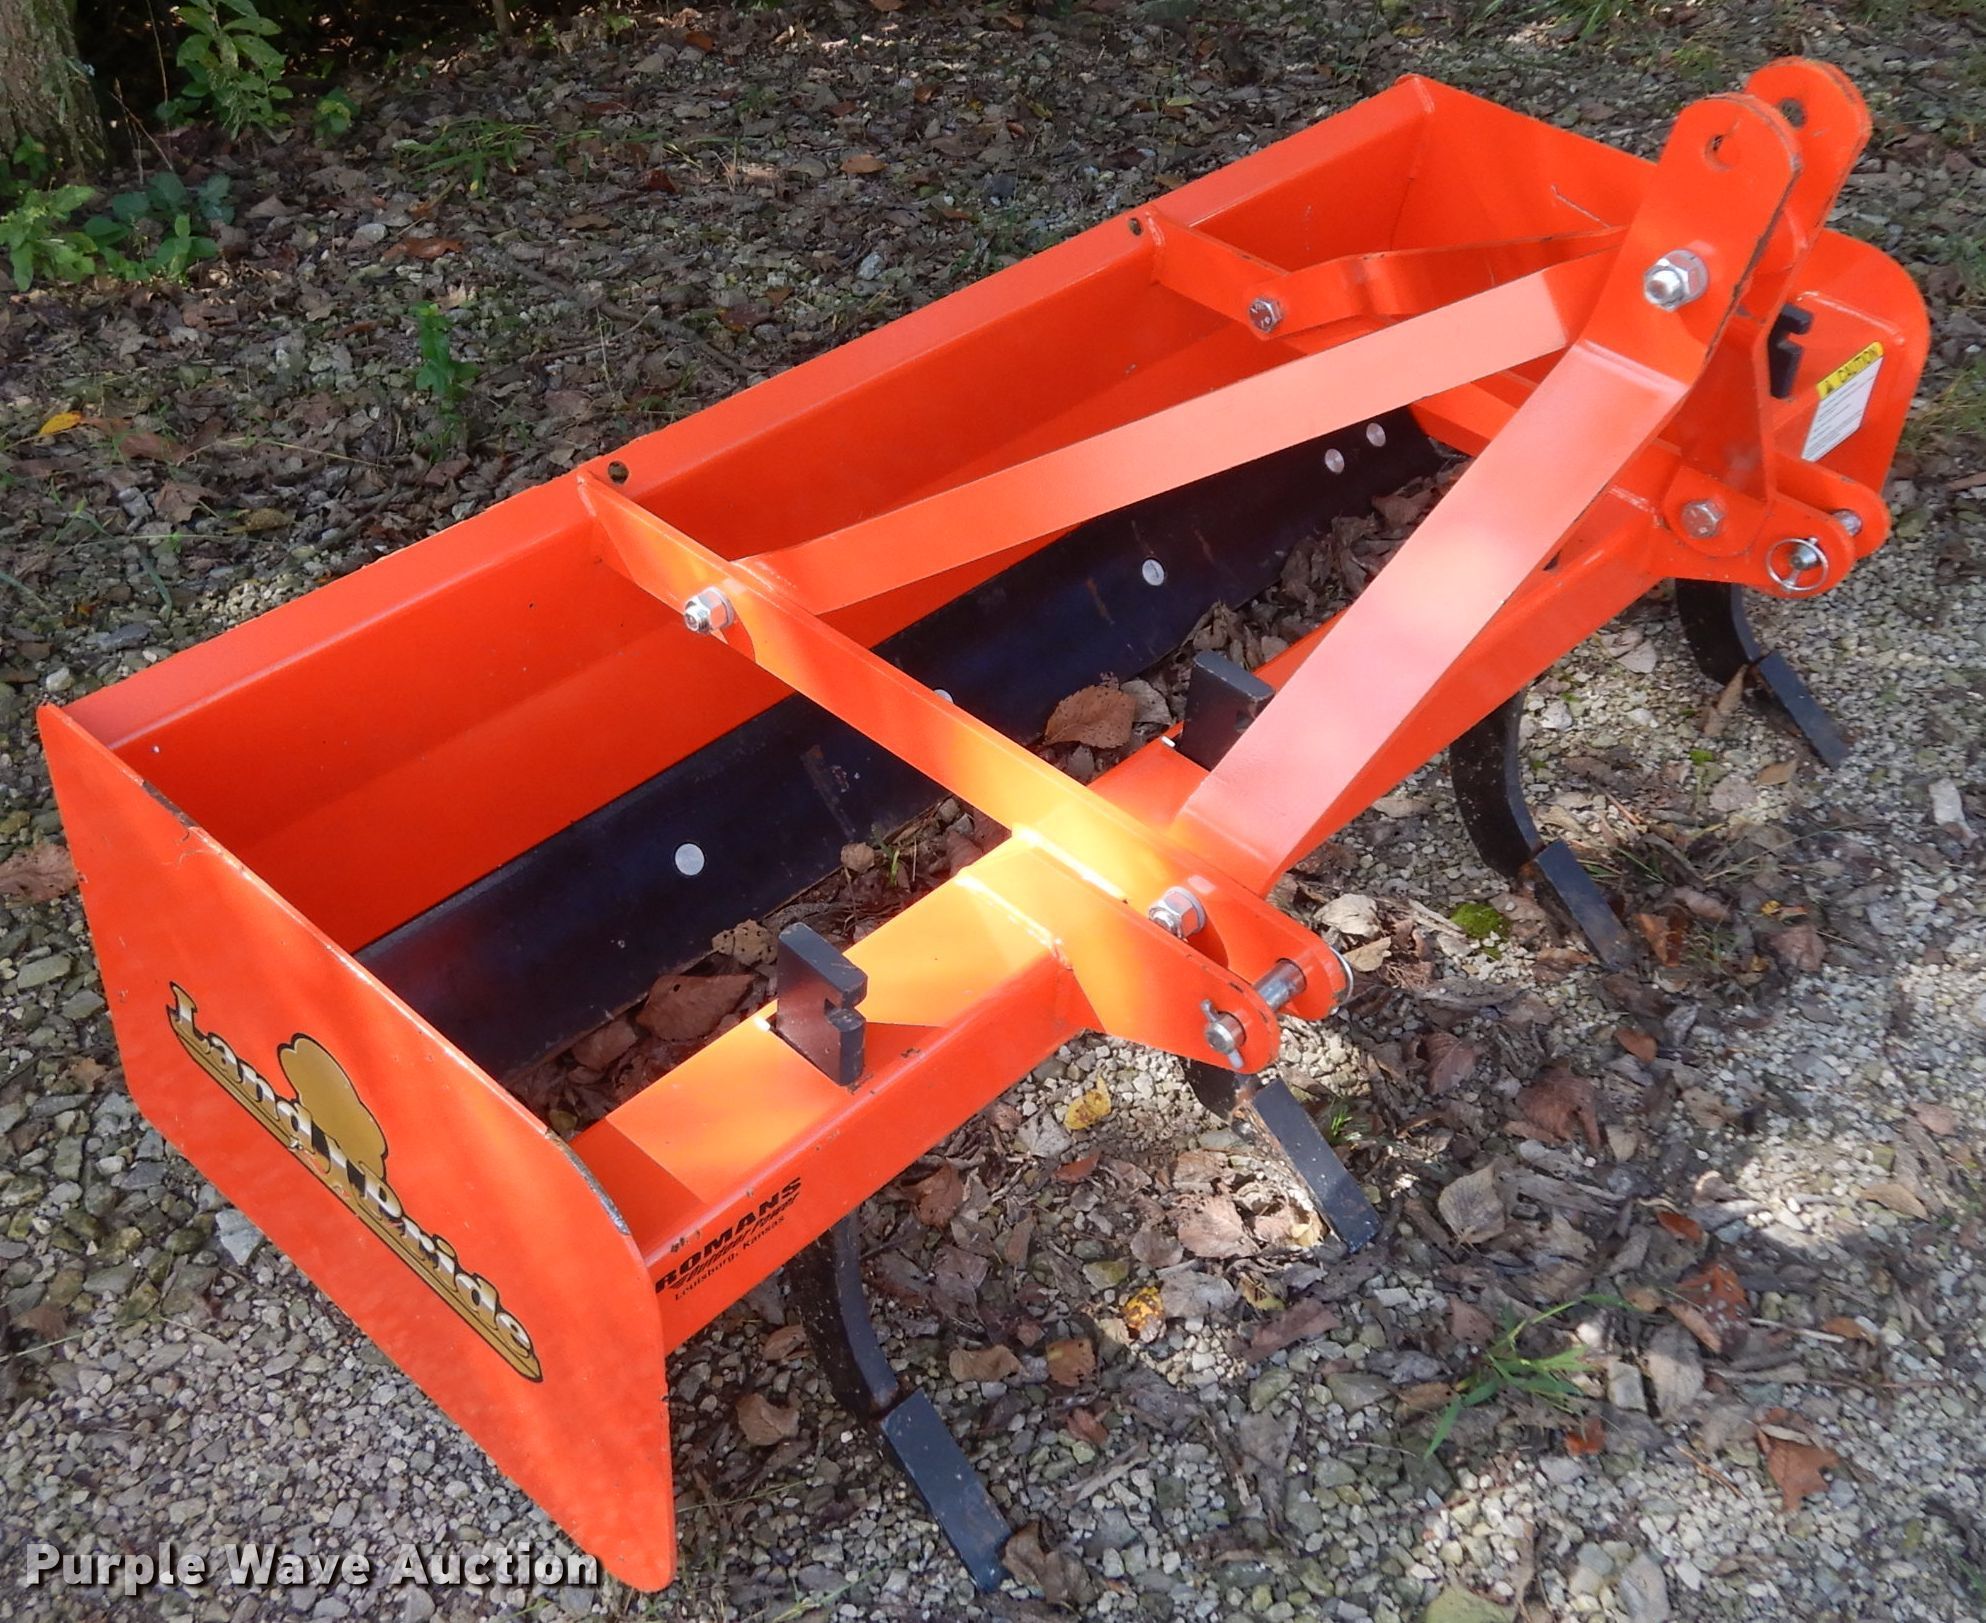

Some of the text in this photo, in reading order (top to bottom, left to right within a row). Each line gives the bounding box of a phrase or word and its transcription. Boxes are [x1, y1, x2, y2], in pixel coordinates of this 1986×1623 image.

[1837, 345, 1880, 384] CAUTION
[167, 980, 535, 1359] Land Pride
[654, 1176, 802, 1294] ROMANS
[742, 1215, 785, 1250] Kansas
